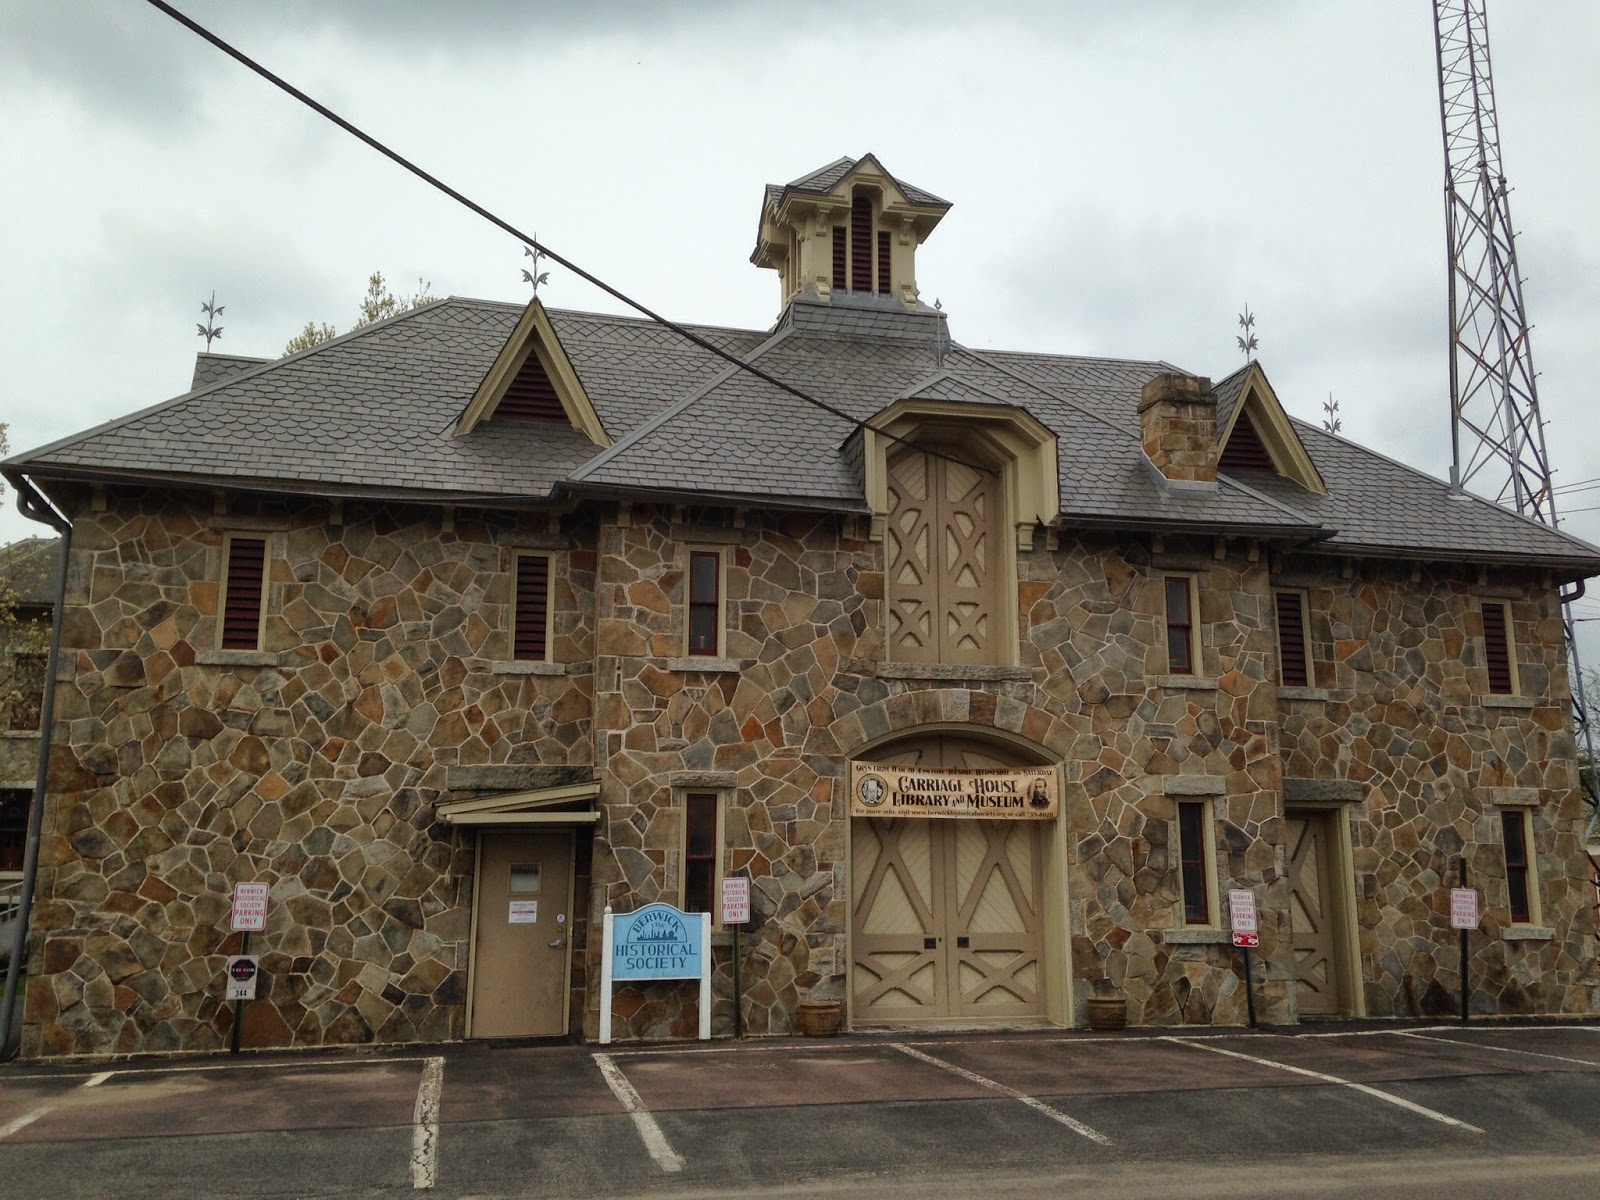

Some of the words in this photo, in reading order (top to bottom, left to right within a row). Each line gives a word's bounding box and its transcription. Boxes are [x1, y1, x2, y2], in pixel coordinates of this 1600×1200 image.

[897, 776, 964, 793] CARRIAGE
[968, 777, 1018, 795] HOUSE
[892, 791, 951, 807] LIBRARY
[967, 793, 1024, 810] MUSEUM
[234, 909, 264, 917] PARKING
[728, 910, 743, 918] ONLY
[240, 917, 257, 925] ONLY
[632, 911, 681, 934] BERWICK
[615, 943, 698, 957] HISTORICAL
[626, 956, 688, 970] SOCIETY
[234, 989, 247, 998] 344
